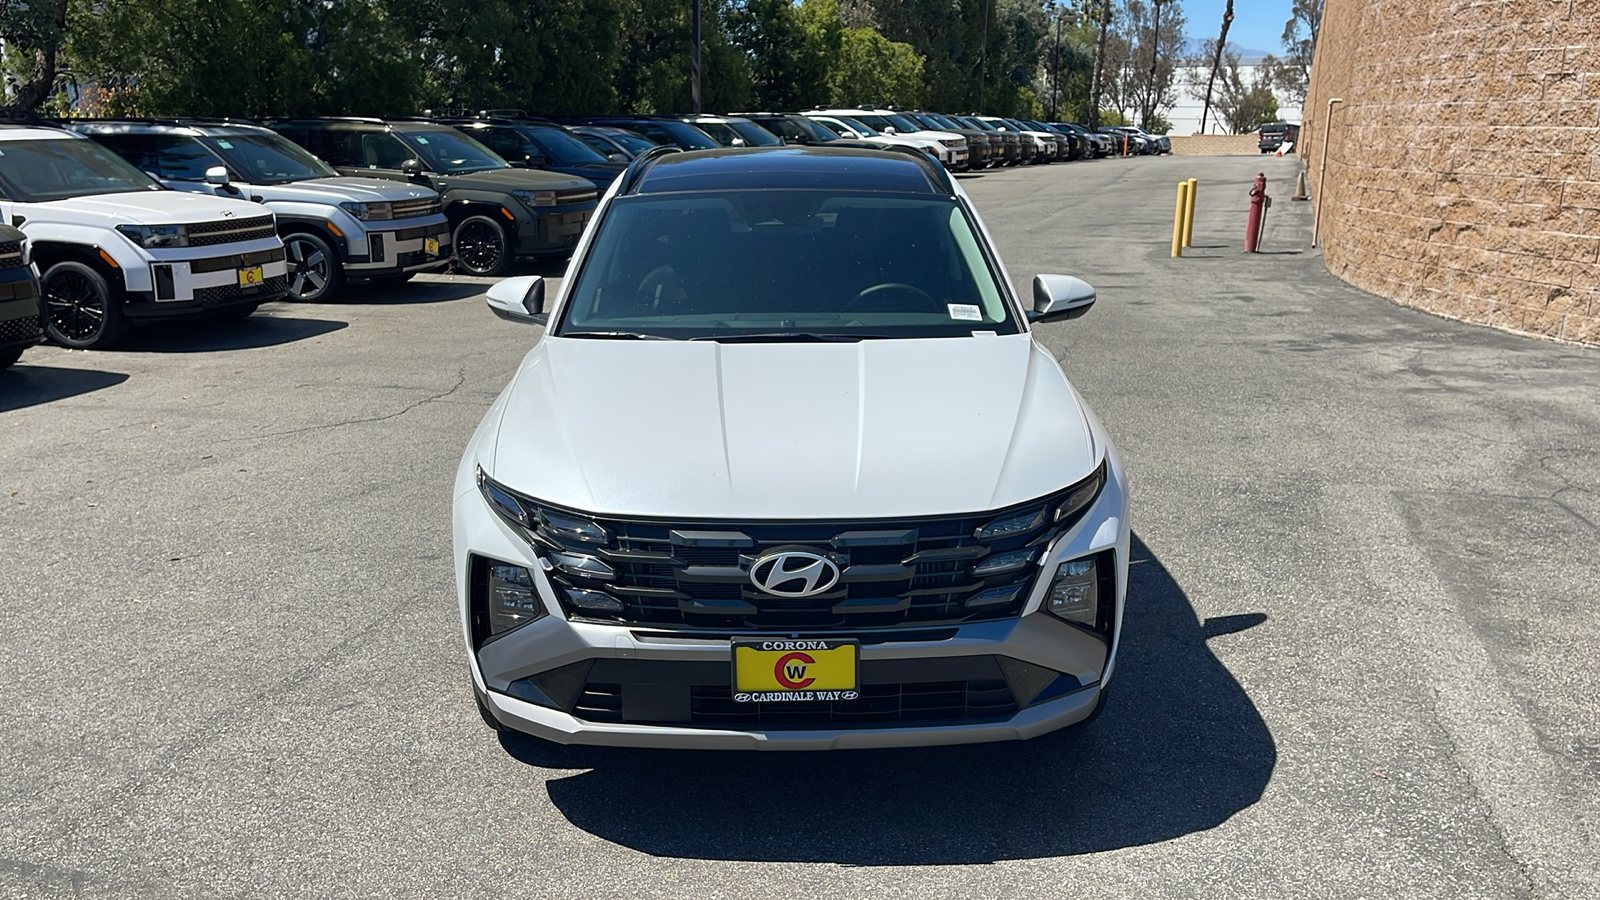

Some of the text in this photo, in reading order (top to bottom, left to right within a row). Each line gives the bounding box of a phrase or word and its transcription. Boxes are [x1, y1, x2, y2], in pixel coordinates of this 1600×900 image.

[762, 641, 828, 650] CORONA
[752, 691, 841, 702] CARDINALE WAY
